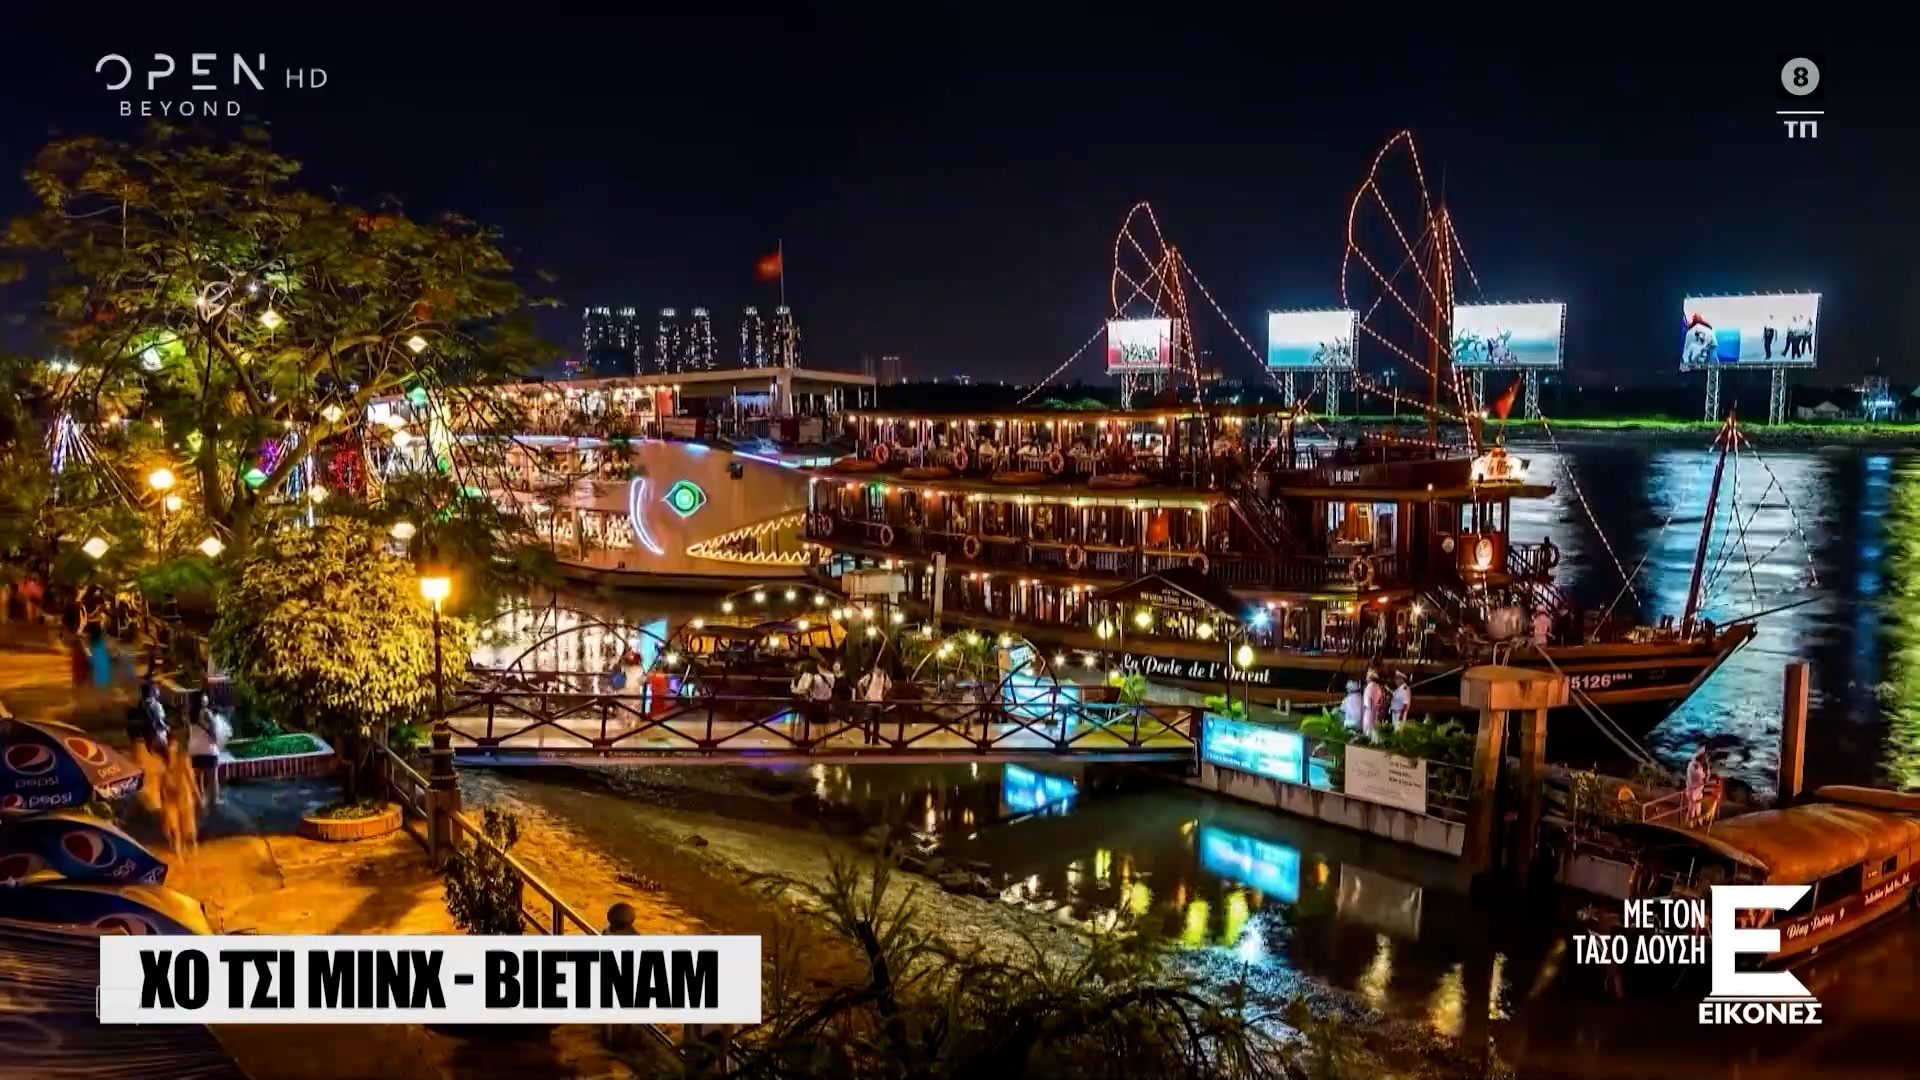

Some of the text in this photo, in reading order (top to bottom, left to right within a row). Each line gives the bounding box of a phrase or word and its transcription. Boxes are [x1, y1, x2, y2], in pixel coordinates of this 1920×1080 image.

[1142, 655, 1182, 675] Perle
[1188, 660, 1206, 678] de
[15, 775, 59, 789] pepsi
[28, 791, 72, 808] pepsi
